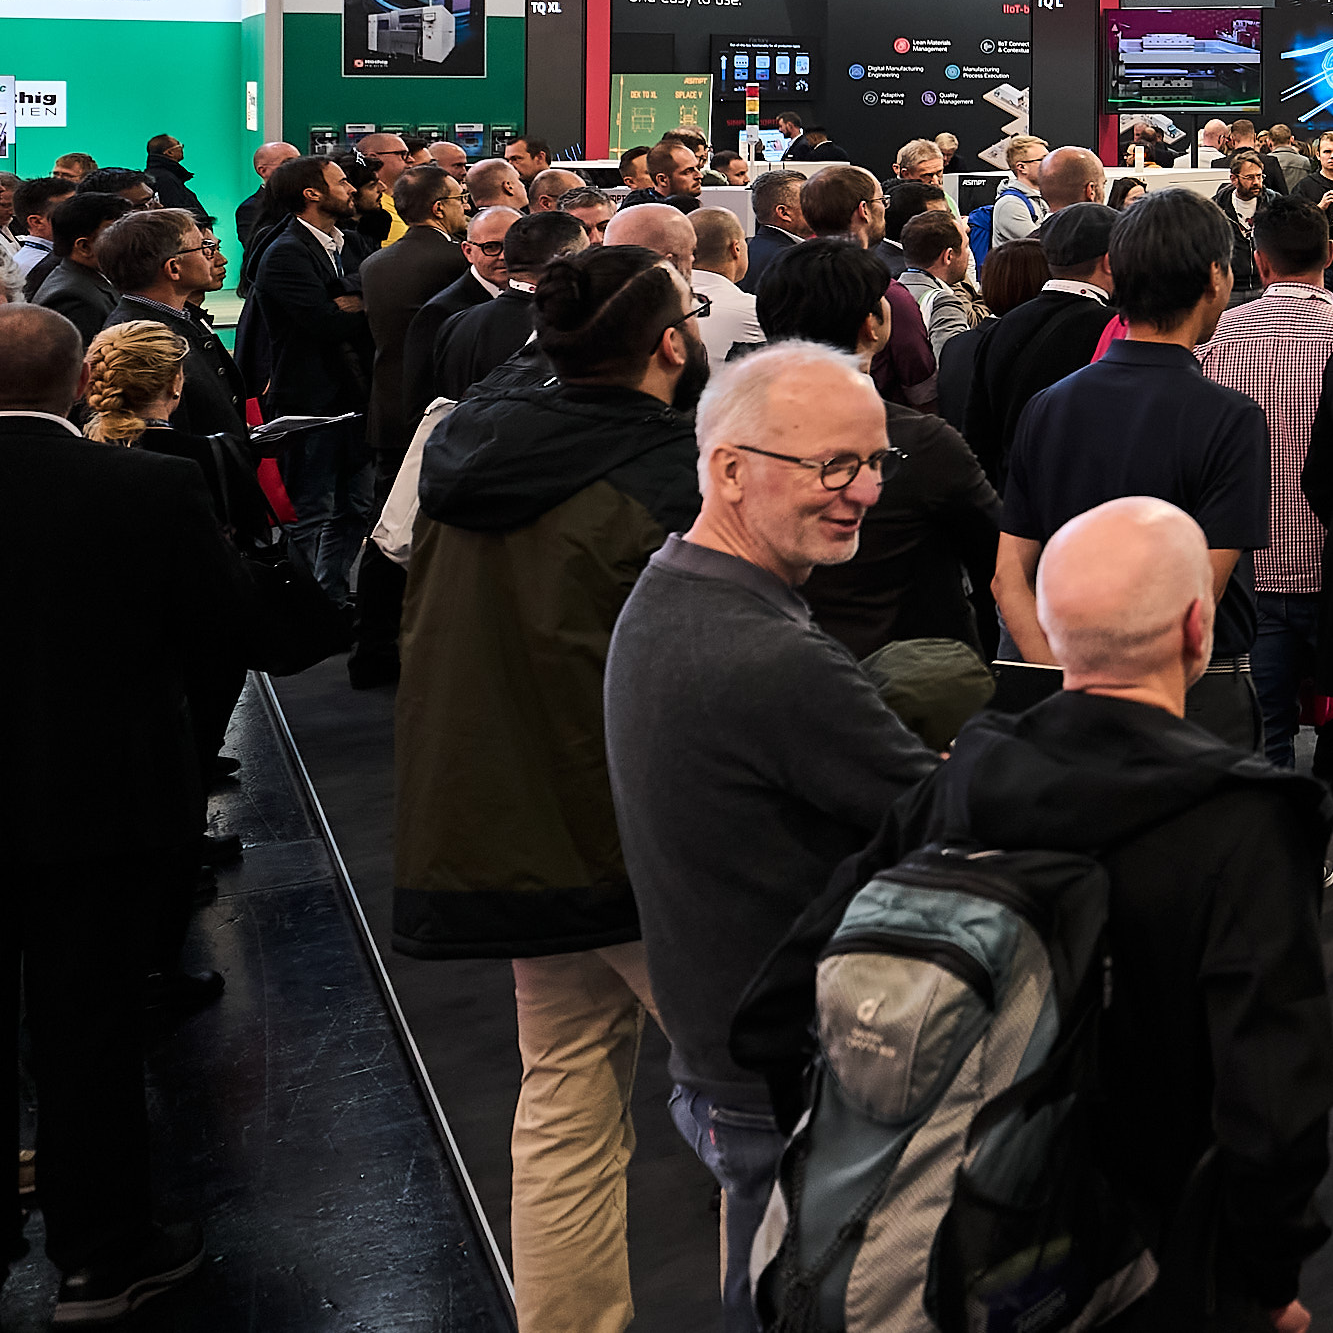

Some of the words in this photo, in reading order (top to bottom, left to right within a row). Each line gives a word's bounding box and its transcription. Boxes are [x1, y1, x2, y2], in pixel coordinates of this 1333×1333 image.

[531, 1, 547, 14] TQ
[547, 1, 562, 13] XL
[867, 65, 886, 73] Digital
[962, 66, 1000, 74] Manufacturing
[939, 92, 959, 100] Quality
